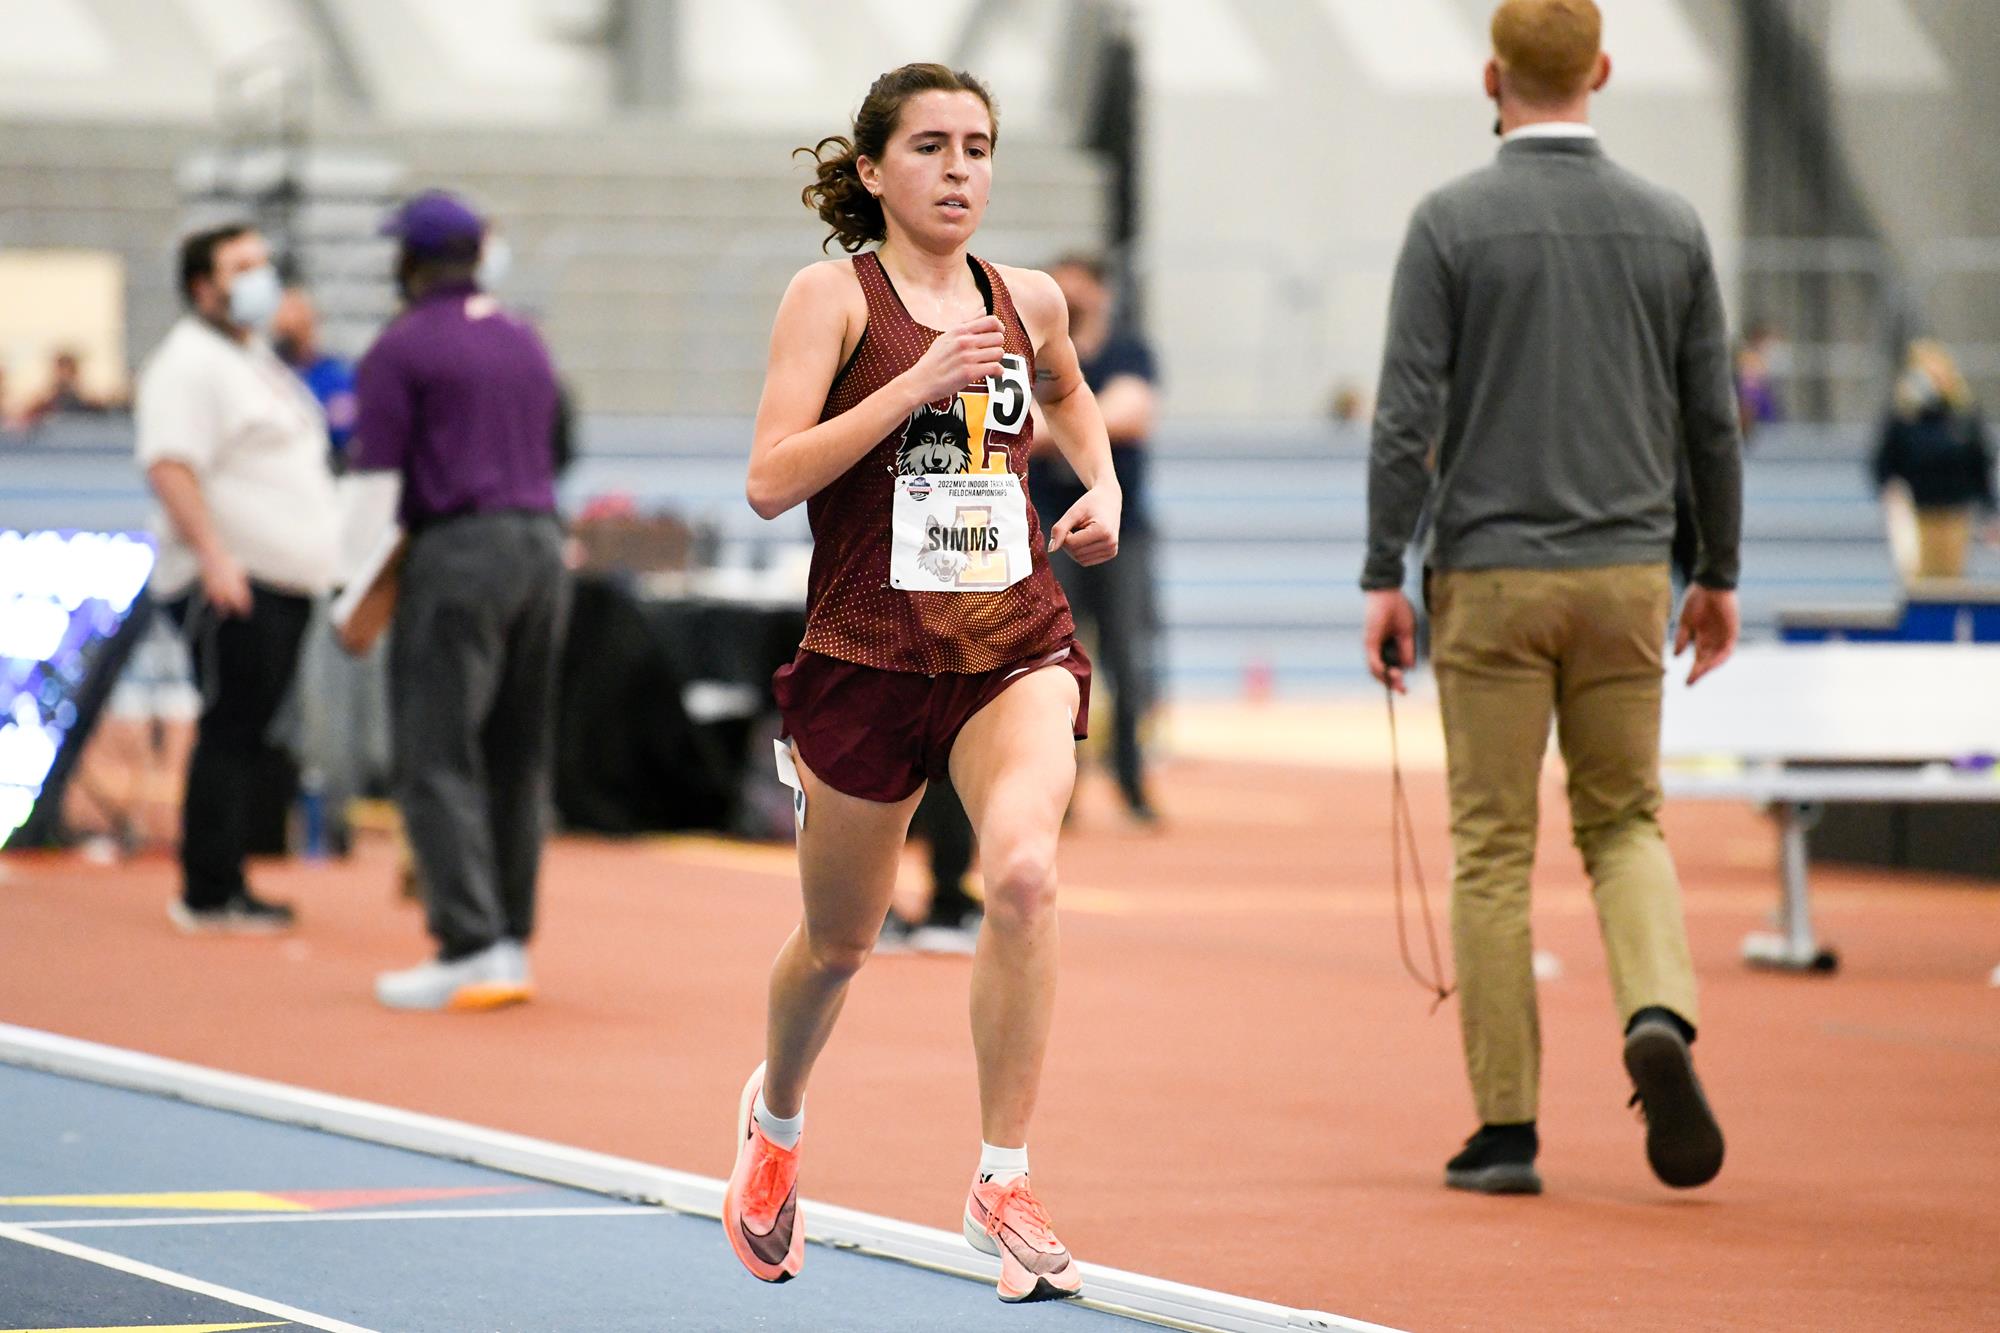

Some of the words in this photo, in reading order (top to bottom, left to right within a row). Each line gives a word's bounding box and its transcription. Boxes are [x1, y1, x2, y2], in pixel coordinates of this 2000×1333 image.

[992, 358, 1024, 427] 5
[937, 480, 953, 488] 2022
[953, 480, 967, 488] MVC
[967, 480, 989, 488] INDOOR
[948, 488, 965, 496] FIELD
[965, 488, 1008, 497] CHAMPIONSHIPS
[928, 526, 999, 551] SIMMS
